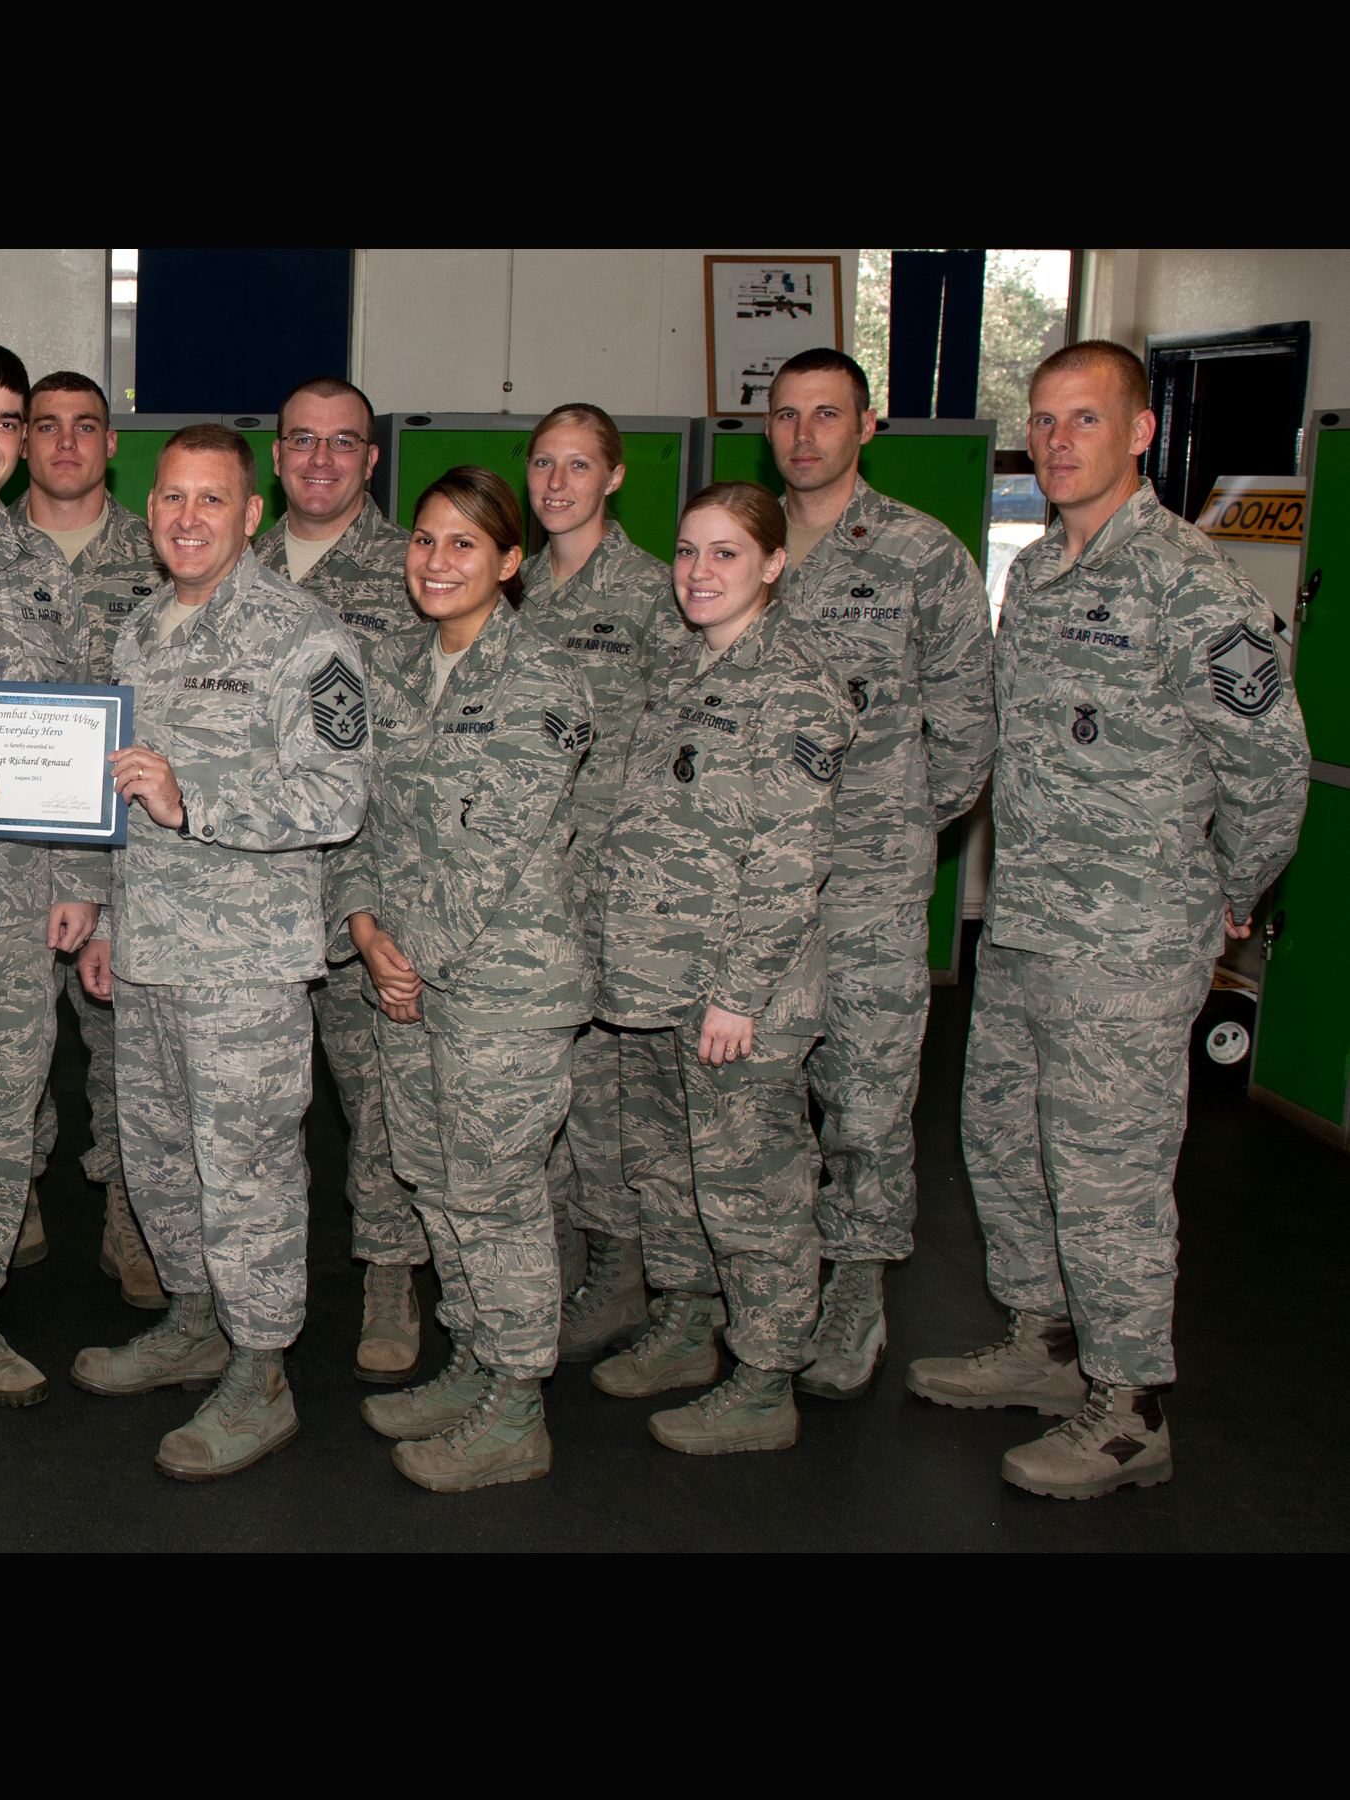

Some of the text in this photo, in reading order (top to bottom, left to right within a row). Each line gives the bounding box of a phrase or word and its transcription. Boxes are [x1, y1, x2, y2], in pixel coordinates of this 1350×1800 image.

[1211, 500, 1305, 533] CHOOL
[821, 606, 901, 620] U.S. AIR FORCE
[355, 614, 389, 631] FORCE
[1075, 628, 1092, 642] AIR
[1093, 631, 1130, 648] FORCE
[584, 638, 600, 651] AIR
[601, 641, 632, 656] FORCE
[184, 677, 249, 694] U.S. AIR FORCE
[29, 708, 70, 725] Support
[72, 713, 100, 731] Wing
[454, 722, 468, 734] AIR
[468, 720, 495, 734] FORCE
[690, 708, 705, 723] AIR
[702, 713, 738, 736] FORCE
[40, 727, 63, 737] Hero
[9, 742, 26, 751] hereby
[8, 756, 39, 766] Richard
[40, 757, 73, 767] Renaud
